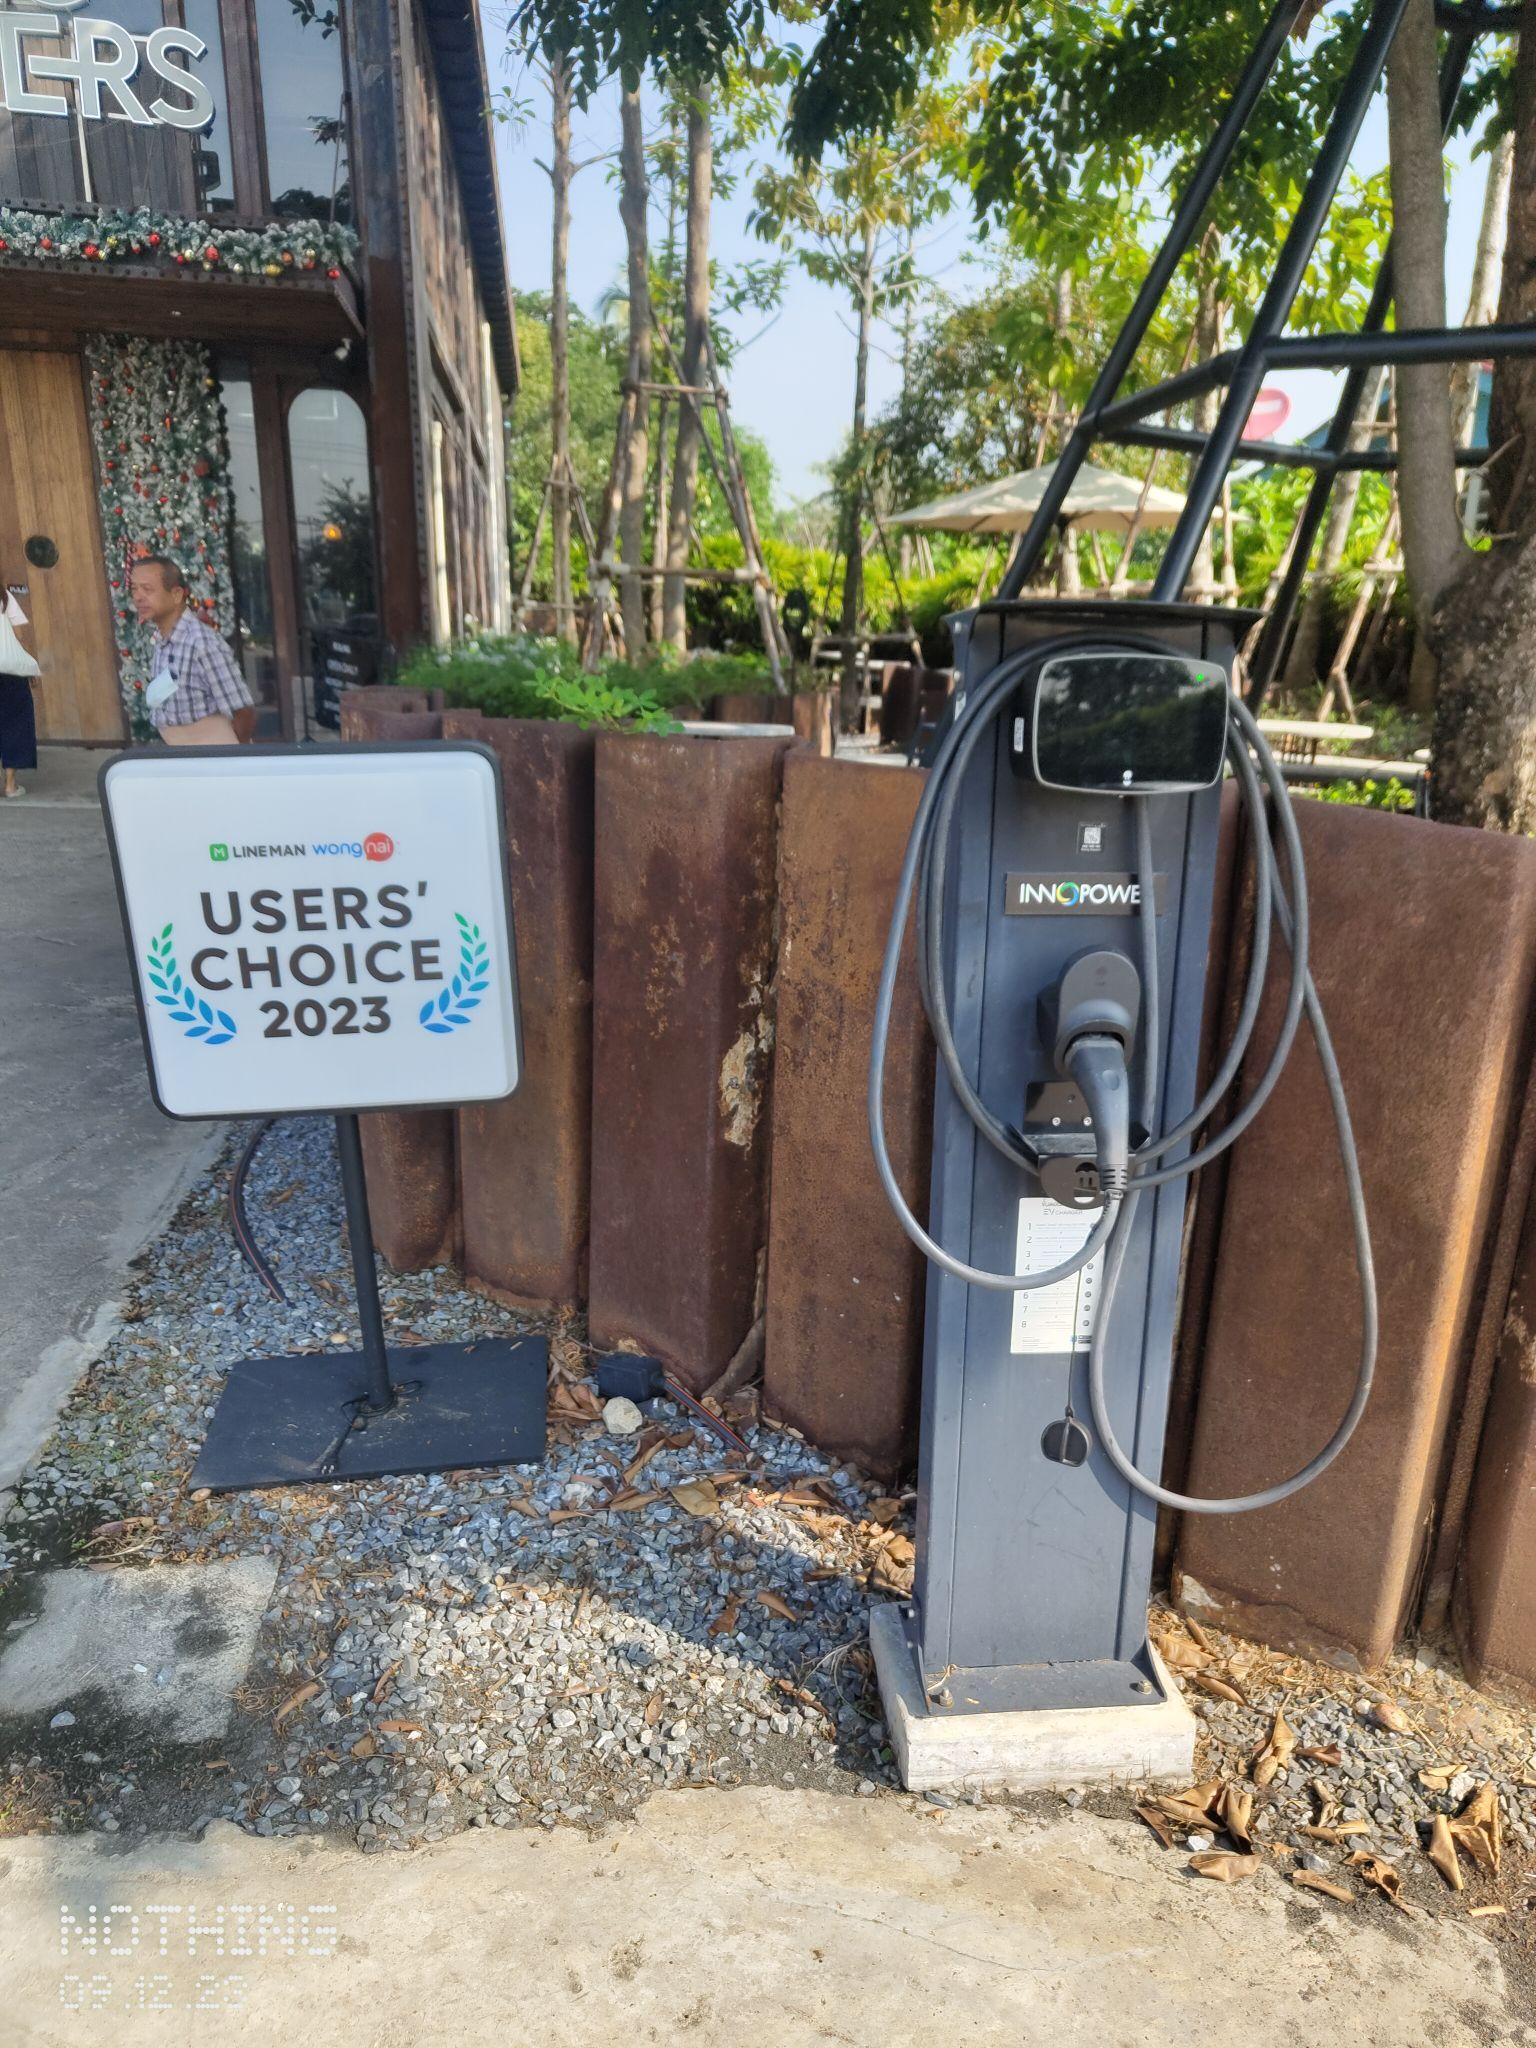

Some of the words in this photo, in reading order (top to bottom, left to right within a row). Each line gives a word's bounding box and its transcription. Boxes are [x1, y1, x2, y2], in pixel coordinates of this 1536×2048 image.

[1019, 881, 1142, 907] INNOPOWE
[200, 880, 428, 936] USERS'
[190, 939, 444, 991] CHOICE
[258, 995, 391, 1039] 2023
[1025, 1250, 1031, 1258] 3
[1023, 1291, 1029, 1300] 6
[1023, 1305, 1029, 1313] 7
